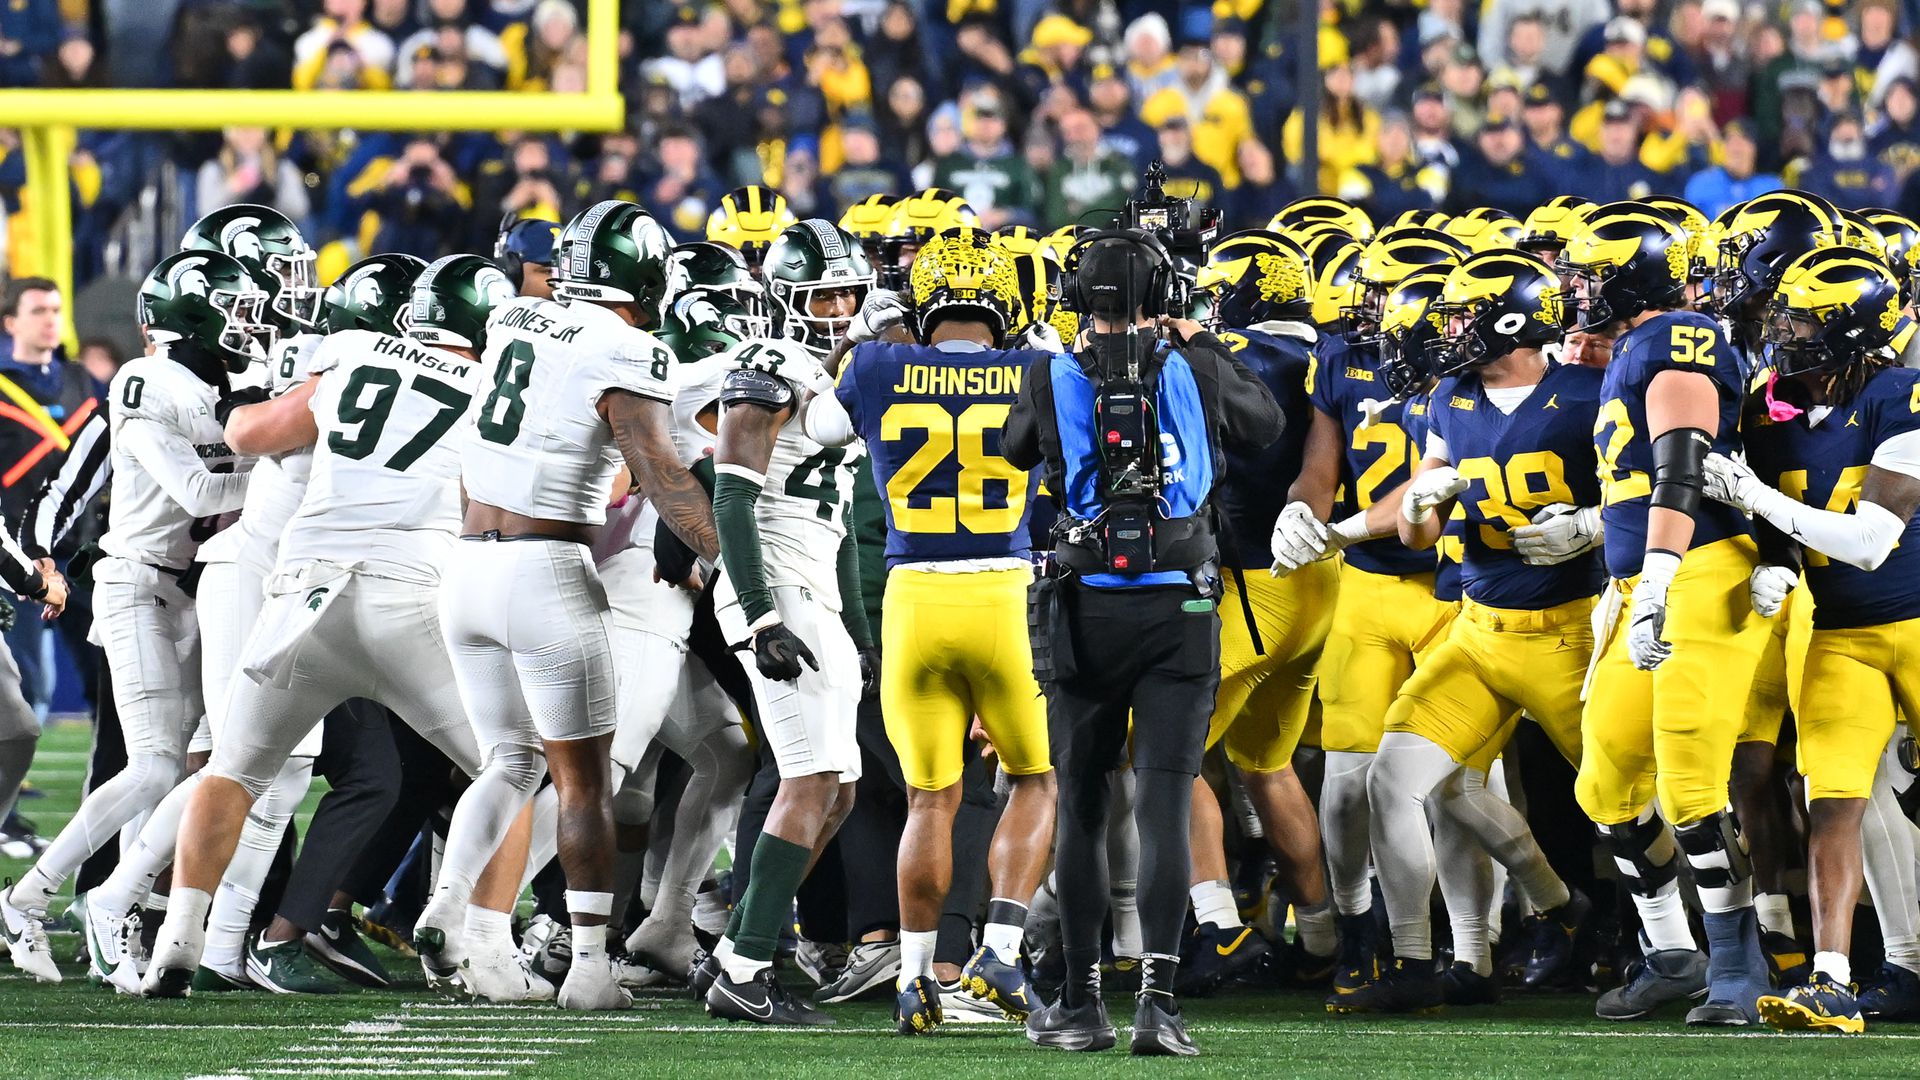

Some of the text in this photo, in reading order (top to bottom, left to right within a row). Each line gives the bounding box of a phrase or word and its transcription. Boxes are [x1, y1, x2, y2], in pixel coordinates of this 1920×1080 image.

[831, 269, 848, 277] STATE
[564, 286, 603, 298] SPARTANS
[498, 306, 556, 334] JONES
[279, 346, 299, 379] 6
[373, 336, 472, 379] HANSEN
[734, 343, 786, 376] 43
[1670, 325, 1716, 367] 52
[650, 346, 670, 382] 8
[893, 363, 1023, 396] JOHNSON
[122, 375, 145, 410] 0
[477, 338, 536, 447] 8
[327, 364, 473, 473] 97
[880, 403, 1030, 535] 28
[1351, 422, 1421, 511] 2
